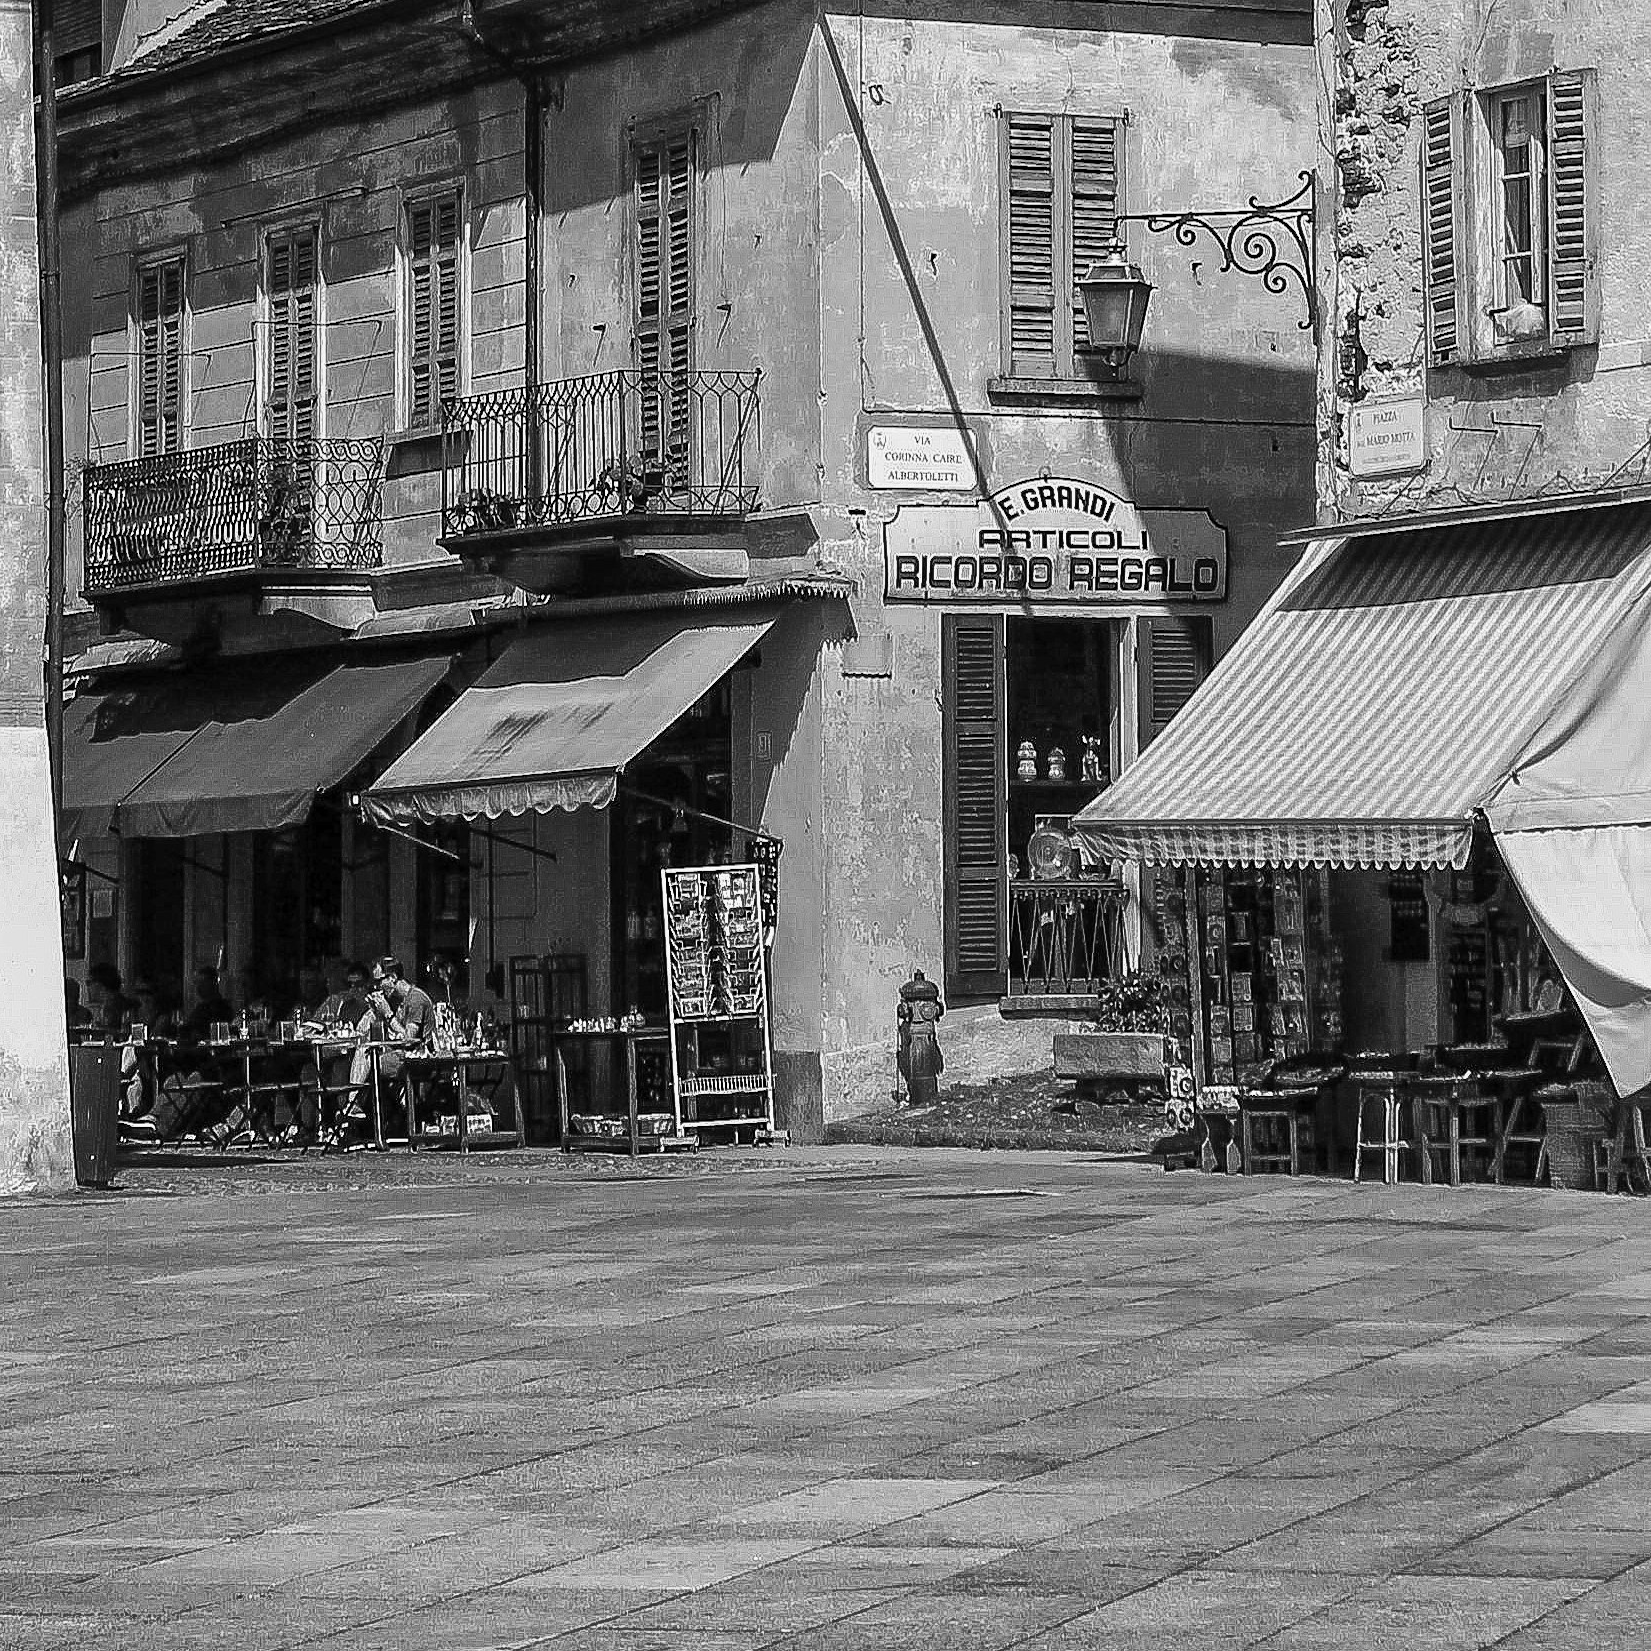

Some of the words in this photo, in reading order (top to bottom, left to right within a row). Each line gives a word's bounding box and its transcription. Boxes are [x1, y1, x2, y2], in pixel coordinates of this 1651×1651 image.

[1372, 410, 1397, 425] PIAZZA
[914, 435, 931, 446] VIA
[1390, 432, 1415, 443] MOTTA
[884, 451, 929, 463] CORINNA
[888, 470, 959, 482] ALBERTOLETTI
[978, 529, 1148, 550] ARTICOLI
[895, 555, 1052, 591] RICORDO
[1068, 556, 1218, 592] REGALO
